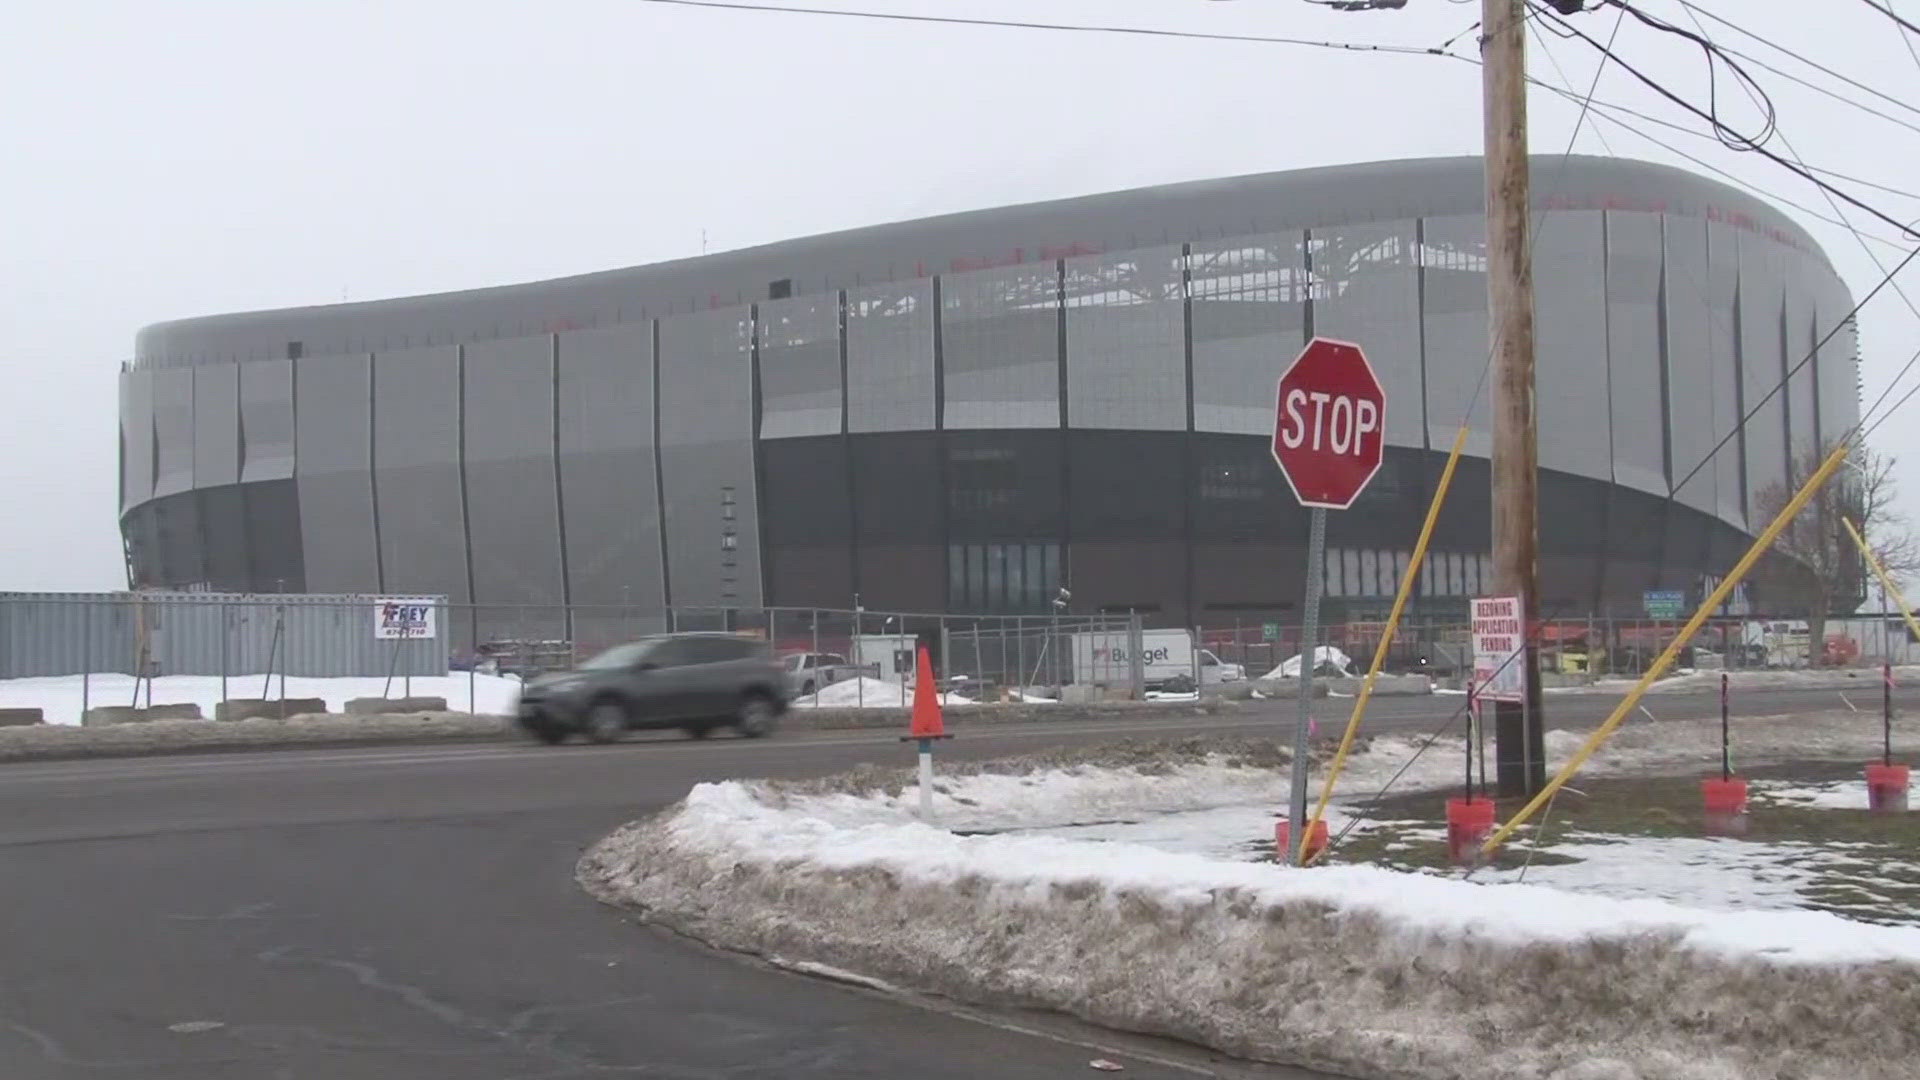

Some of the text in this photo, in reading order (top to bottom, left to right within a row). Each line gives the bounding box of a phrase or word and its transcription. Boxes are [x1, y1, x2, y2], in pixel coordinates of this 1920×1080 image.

[1282, 388, 1377, 456] STOP
[387, 605, 429, 621] FREY
[1477, 602, 1512, 617] REZONING
[1473, 619, 1518, 634] APPLICATION
[1480, 637, 1512, 652] PENDING
[1112, 646, 1168, 665] Buget
